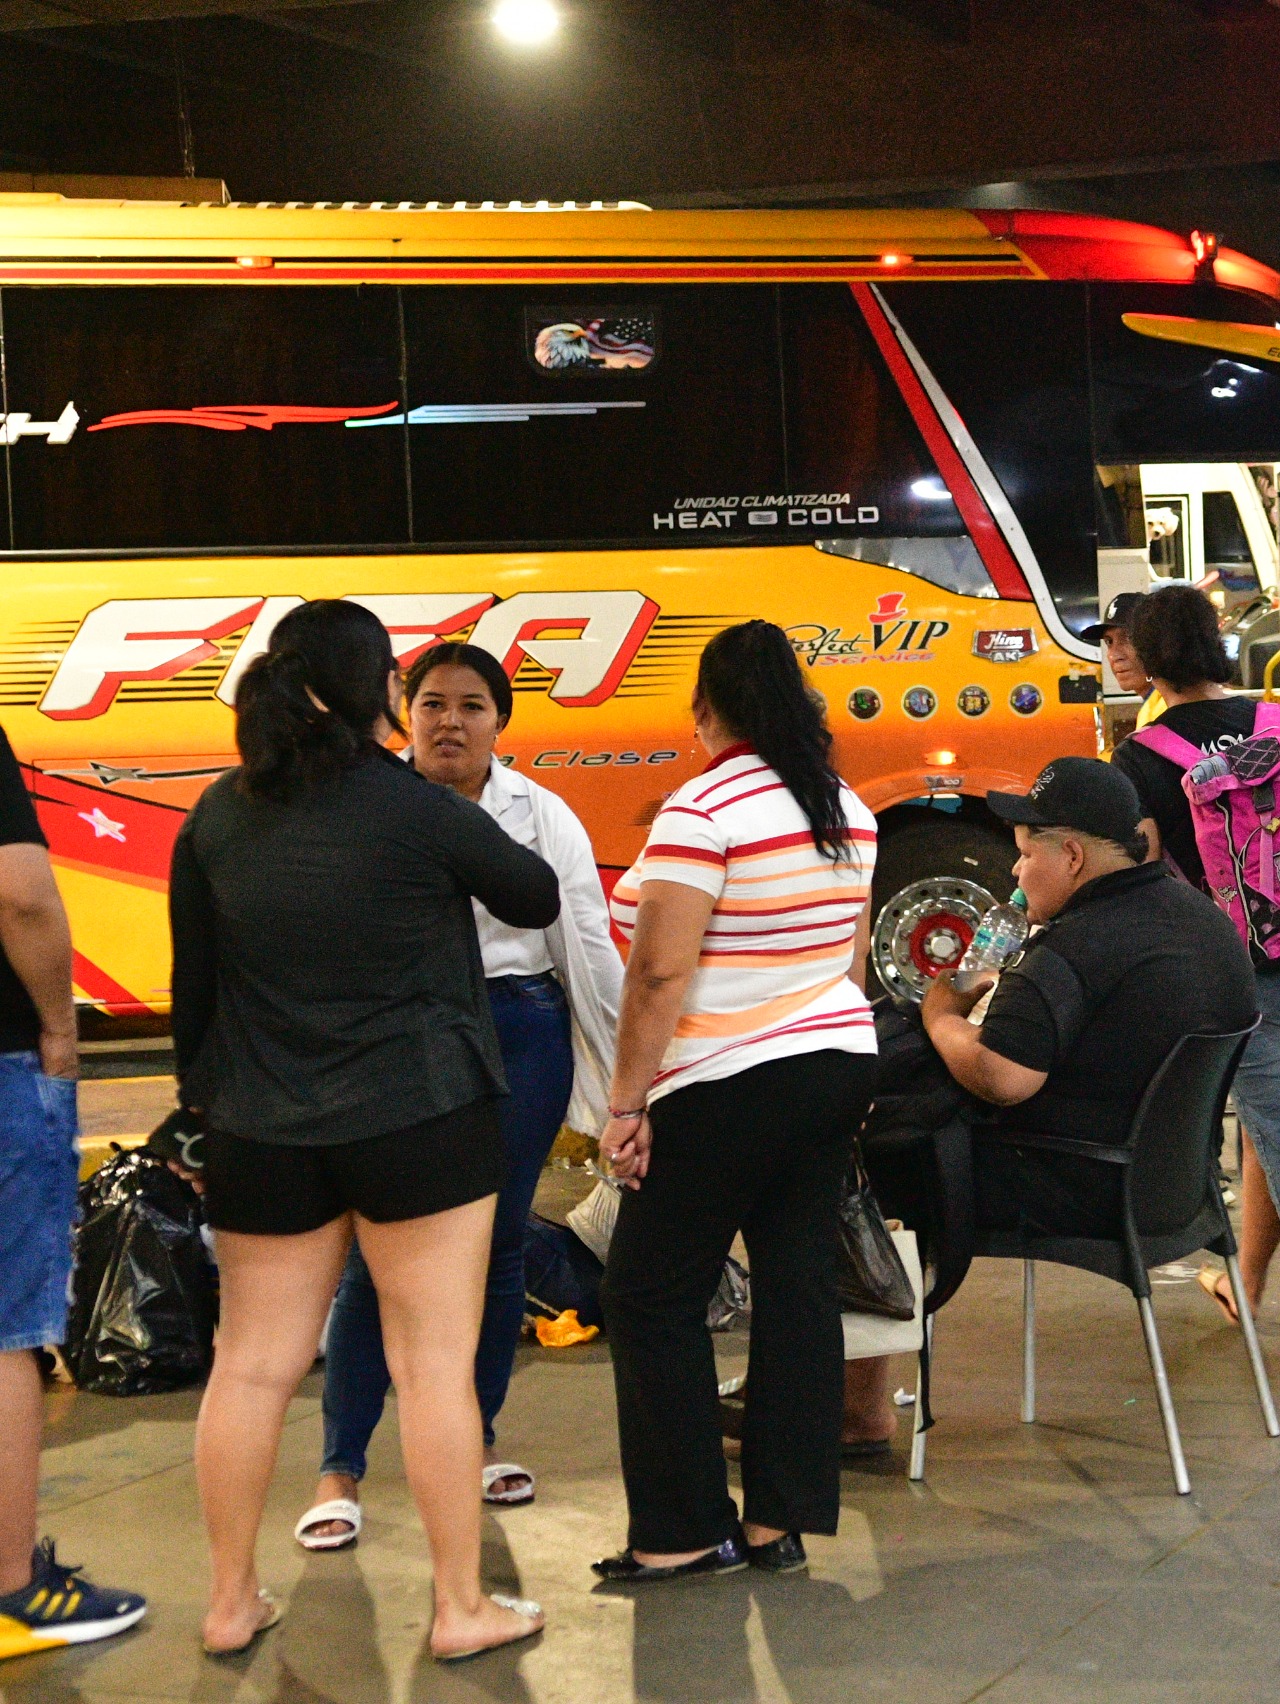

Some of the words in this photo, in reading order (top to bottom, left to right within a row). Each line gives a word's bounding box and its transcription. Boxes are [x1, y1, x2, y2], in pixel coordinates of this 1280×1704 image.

[674, 497, 739, 510] UNIDAD
[741, 493, 851, 507] CLIMATIZADA
[653, 511, 737, 530] HEAT
[787, 506, 879, 525] COLD
[873, 620, 949, 652] VIP
[819, 652, 935, 666] Service
[993, 652, 1017, 661] AK
[532, 749, 679, 768] Clase
